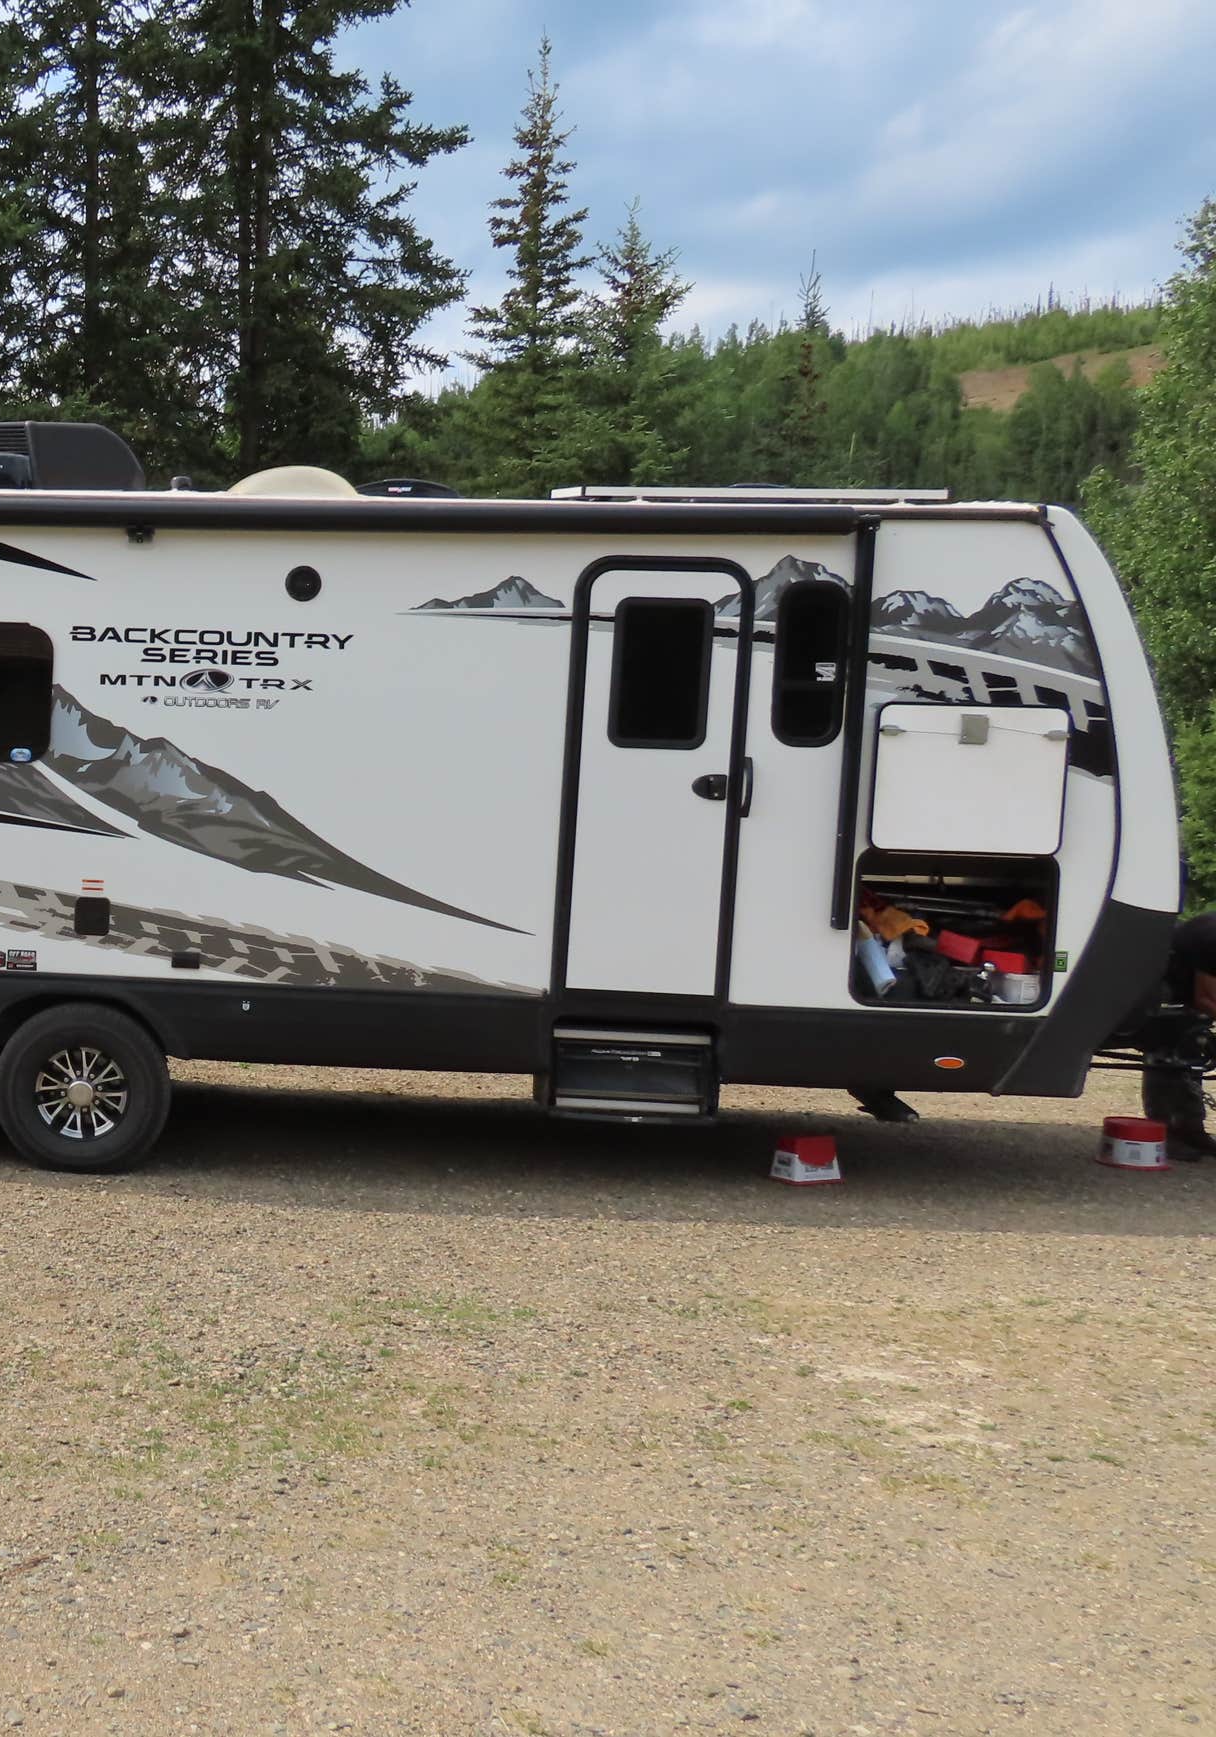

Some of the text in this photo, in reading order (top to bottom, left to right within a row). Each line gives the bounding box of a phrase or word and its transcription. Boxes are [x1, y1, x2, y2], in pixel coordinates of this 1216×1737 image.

[69, 626, 354, 649] BACKCOUNTRY
[140, 648, 279, 666] SERIES
[99, 674, 314, 690] MTN TRX
[164, 696, 250, 709] OUTDOORS
